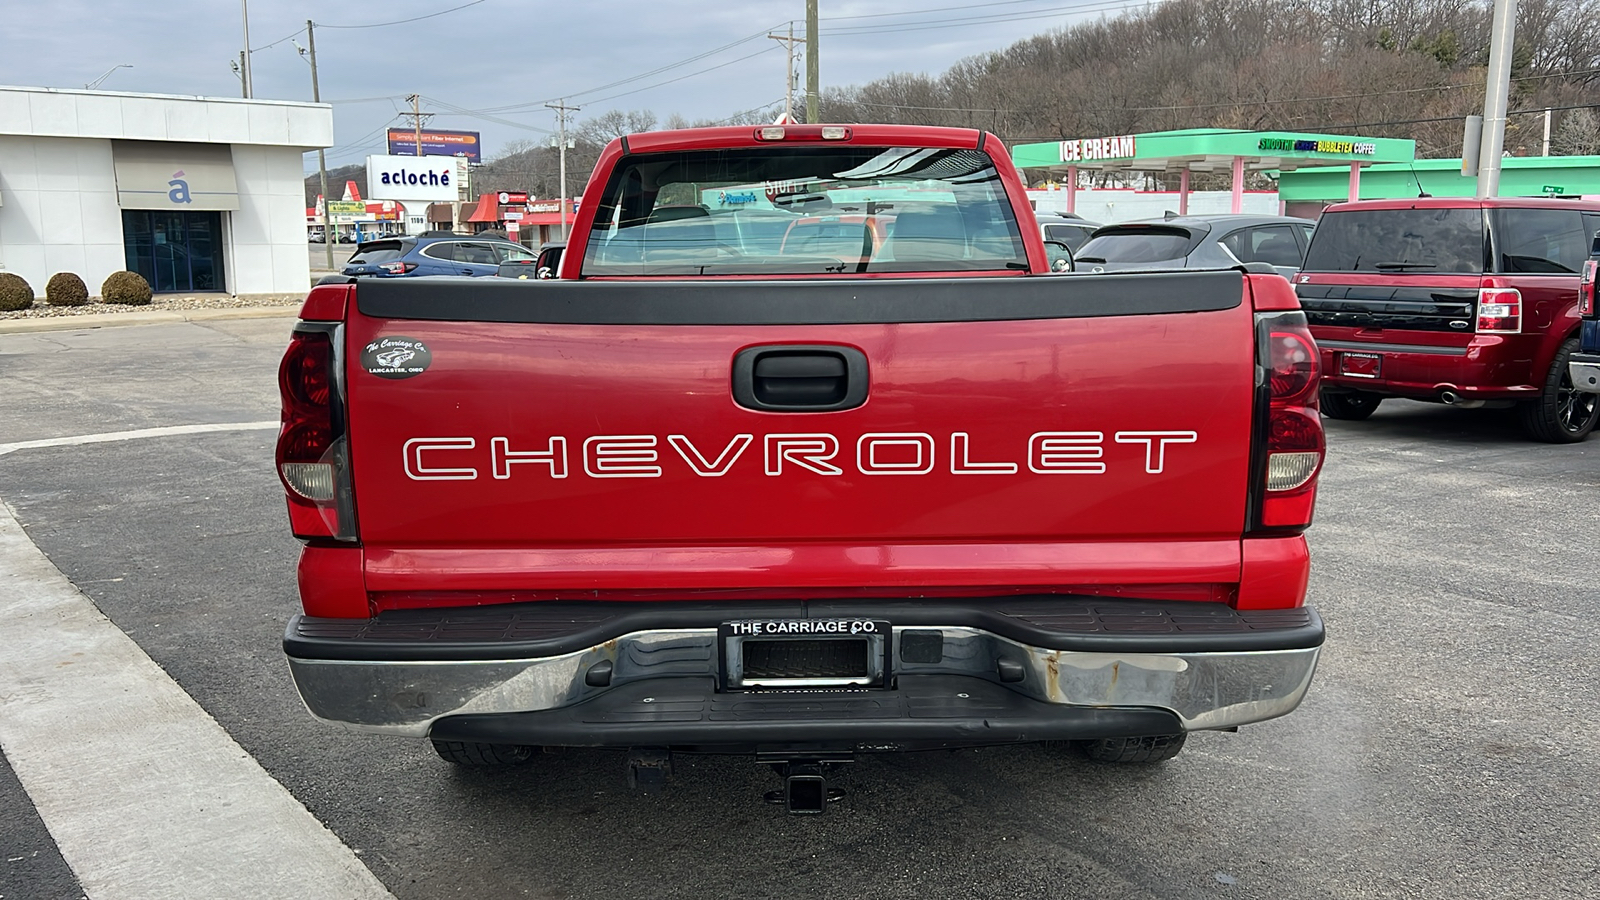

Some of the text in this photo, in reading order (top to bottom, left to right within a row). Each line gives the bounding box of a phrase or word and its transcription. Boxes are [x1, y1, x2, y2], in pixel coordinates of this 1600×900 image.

[1059, 136, 1136, 162] ICE CREAM
[1353, 142, 1376, 155] COFFEE
[381, 168, 450, 186] acloché
[167, 170, 192, 204] á
[366, 338, 427, 353] The Carriage Co.
[403, 430, 1198, 481] CHEVROLET
[730, 620, 879, 635] THE CARRIAGE CO.
